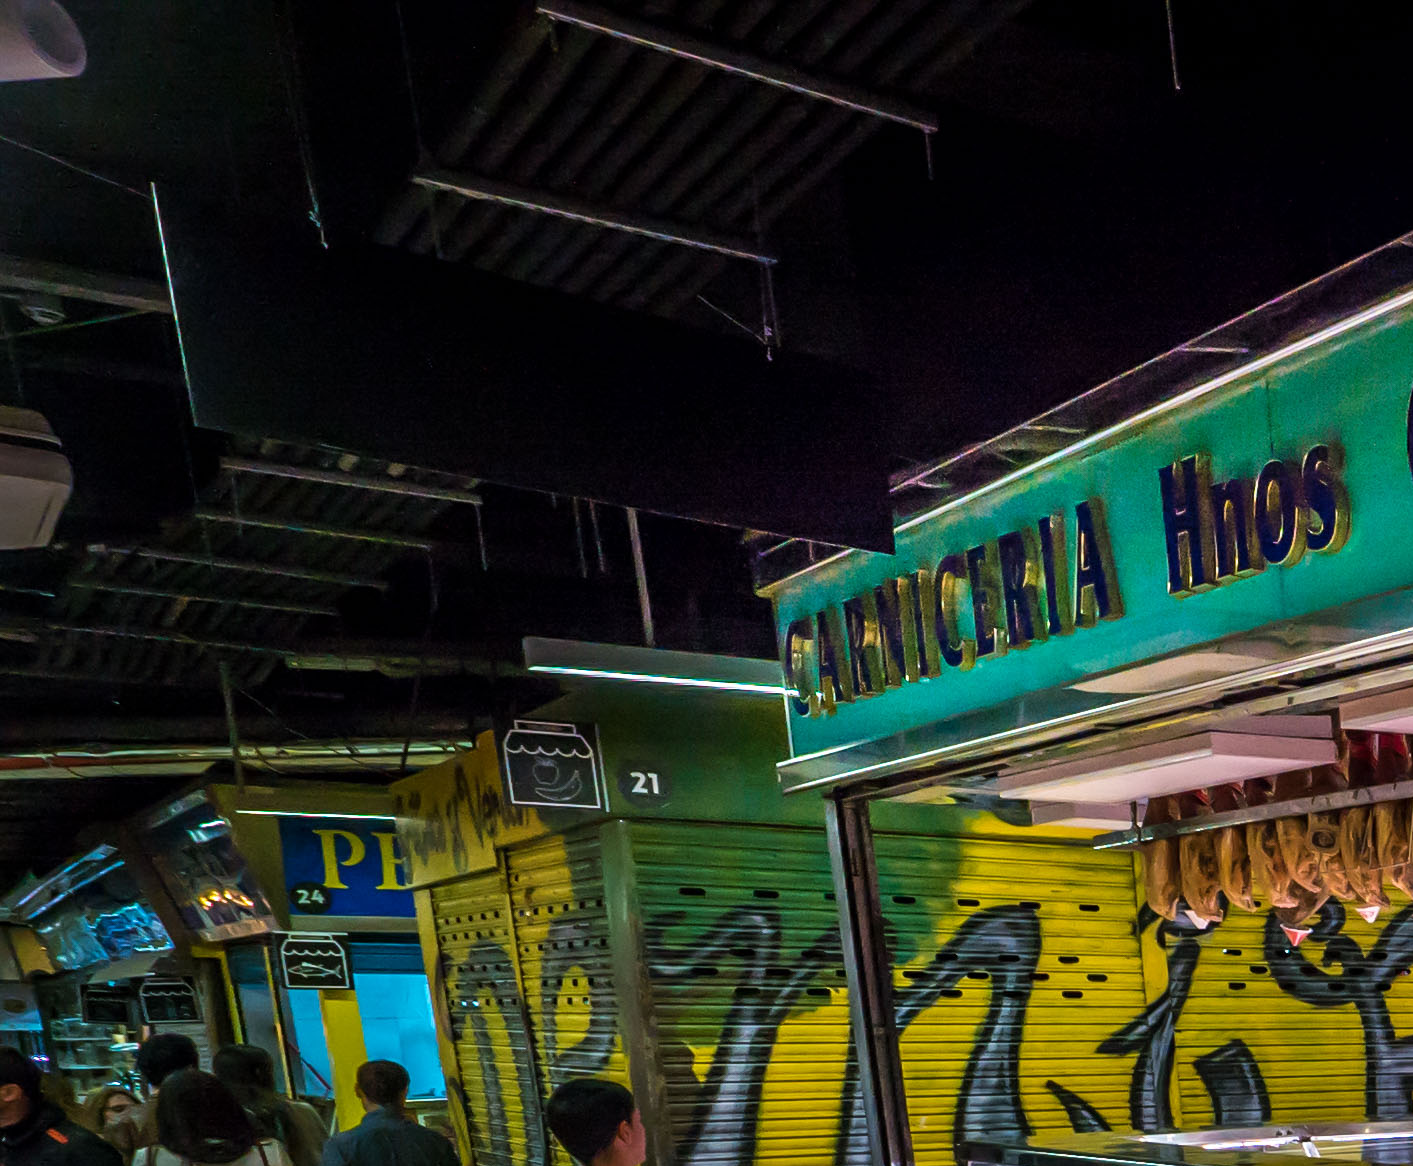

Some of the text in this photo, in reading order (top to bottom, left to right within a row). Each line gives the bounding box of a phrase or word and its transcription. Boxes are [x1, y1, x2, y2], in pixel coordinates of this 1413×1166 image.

[785, 497, 1125, 717] CARNICERIA
[1158, 444, 1352, 599] Hnos
[629, 770, 660, 795] 21
[296, 888, 326, 905] 24
